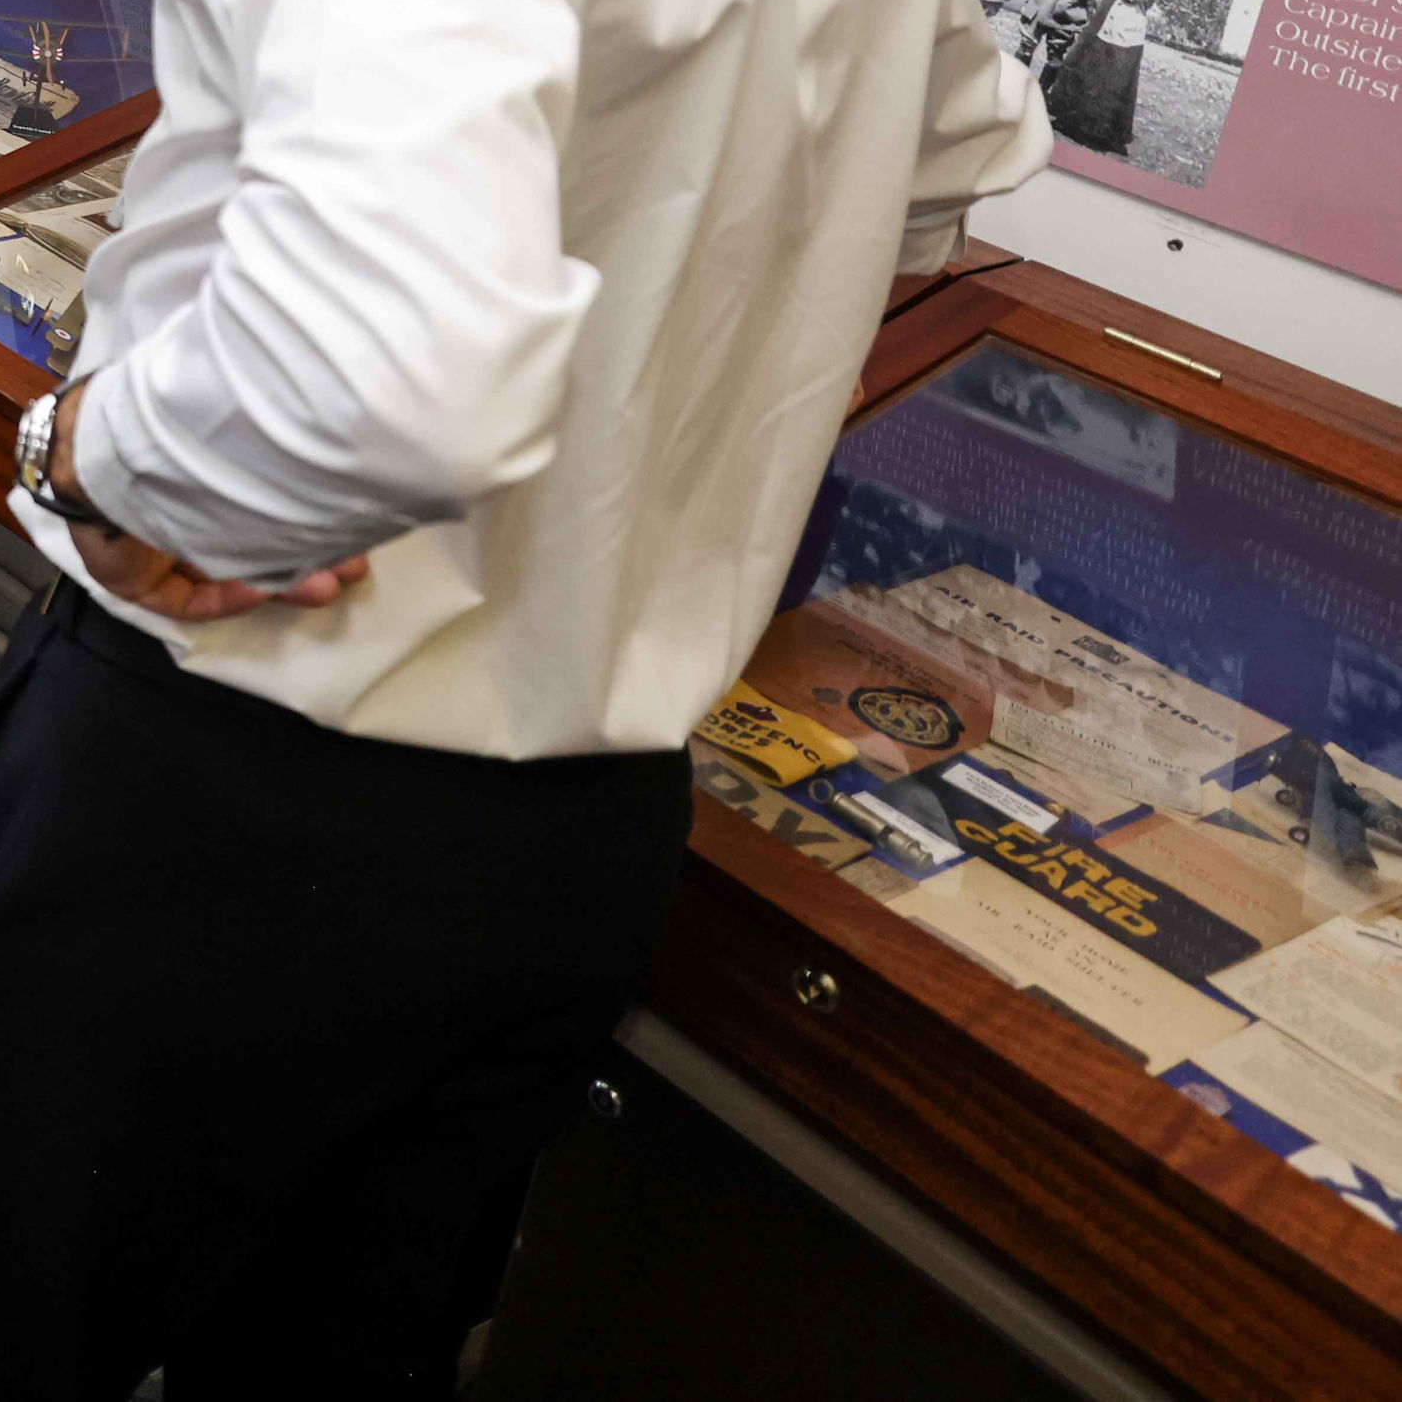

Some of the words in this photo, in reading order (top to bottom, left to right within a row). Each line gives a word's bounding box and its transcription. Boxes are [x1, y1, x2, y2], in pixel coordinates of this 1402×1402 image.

[1268, 46, 1330, 80] The
[1337, 66, 1399, 103] first
[1276, 20, 1402, 72] Outside
[936, 587, 978, 608] AIR
[986, 611, 1045, 645] RAID
[1054, 648, 1235, 743] PRECAUTIONS
[705, 714, 772, 747] ORPS
[954, 819, 1159, 938] GUARD
[998, 821, 1158, 912] FIRE
